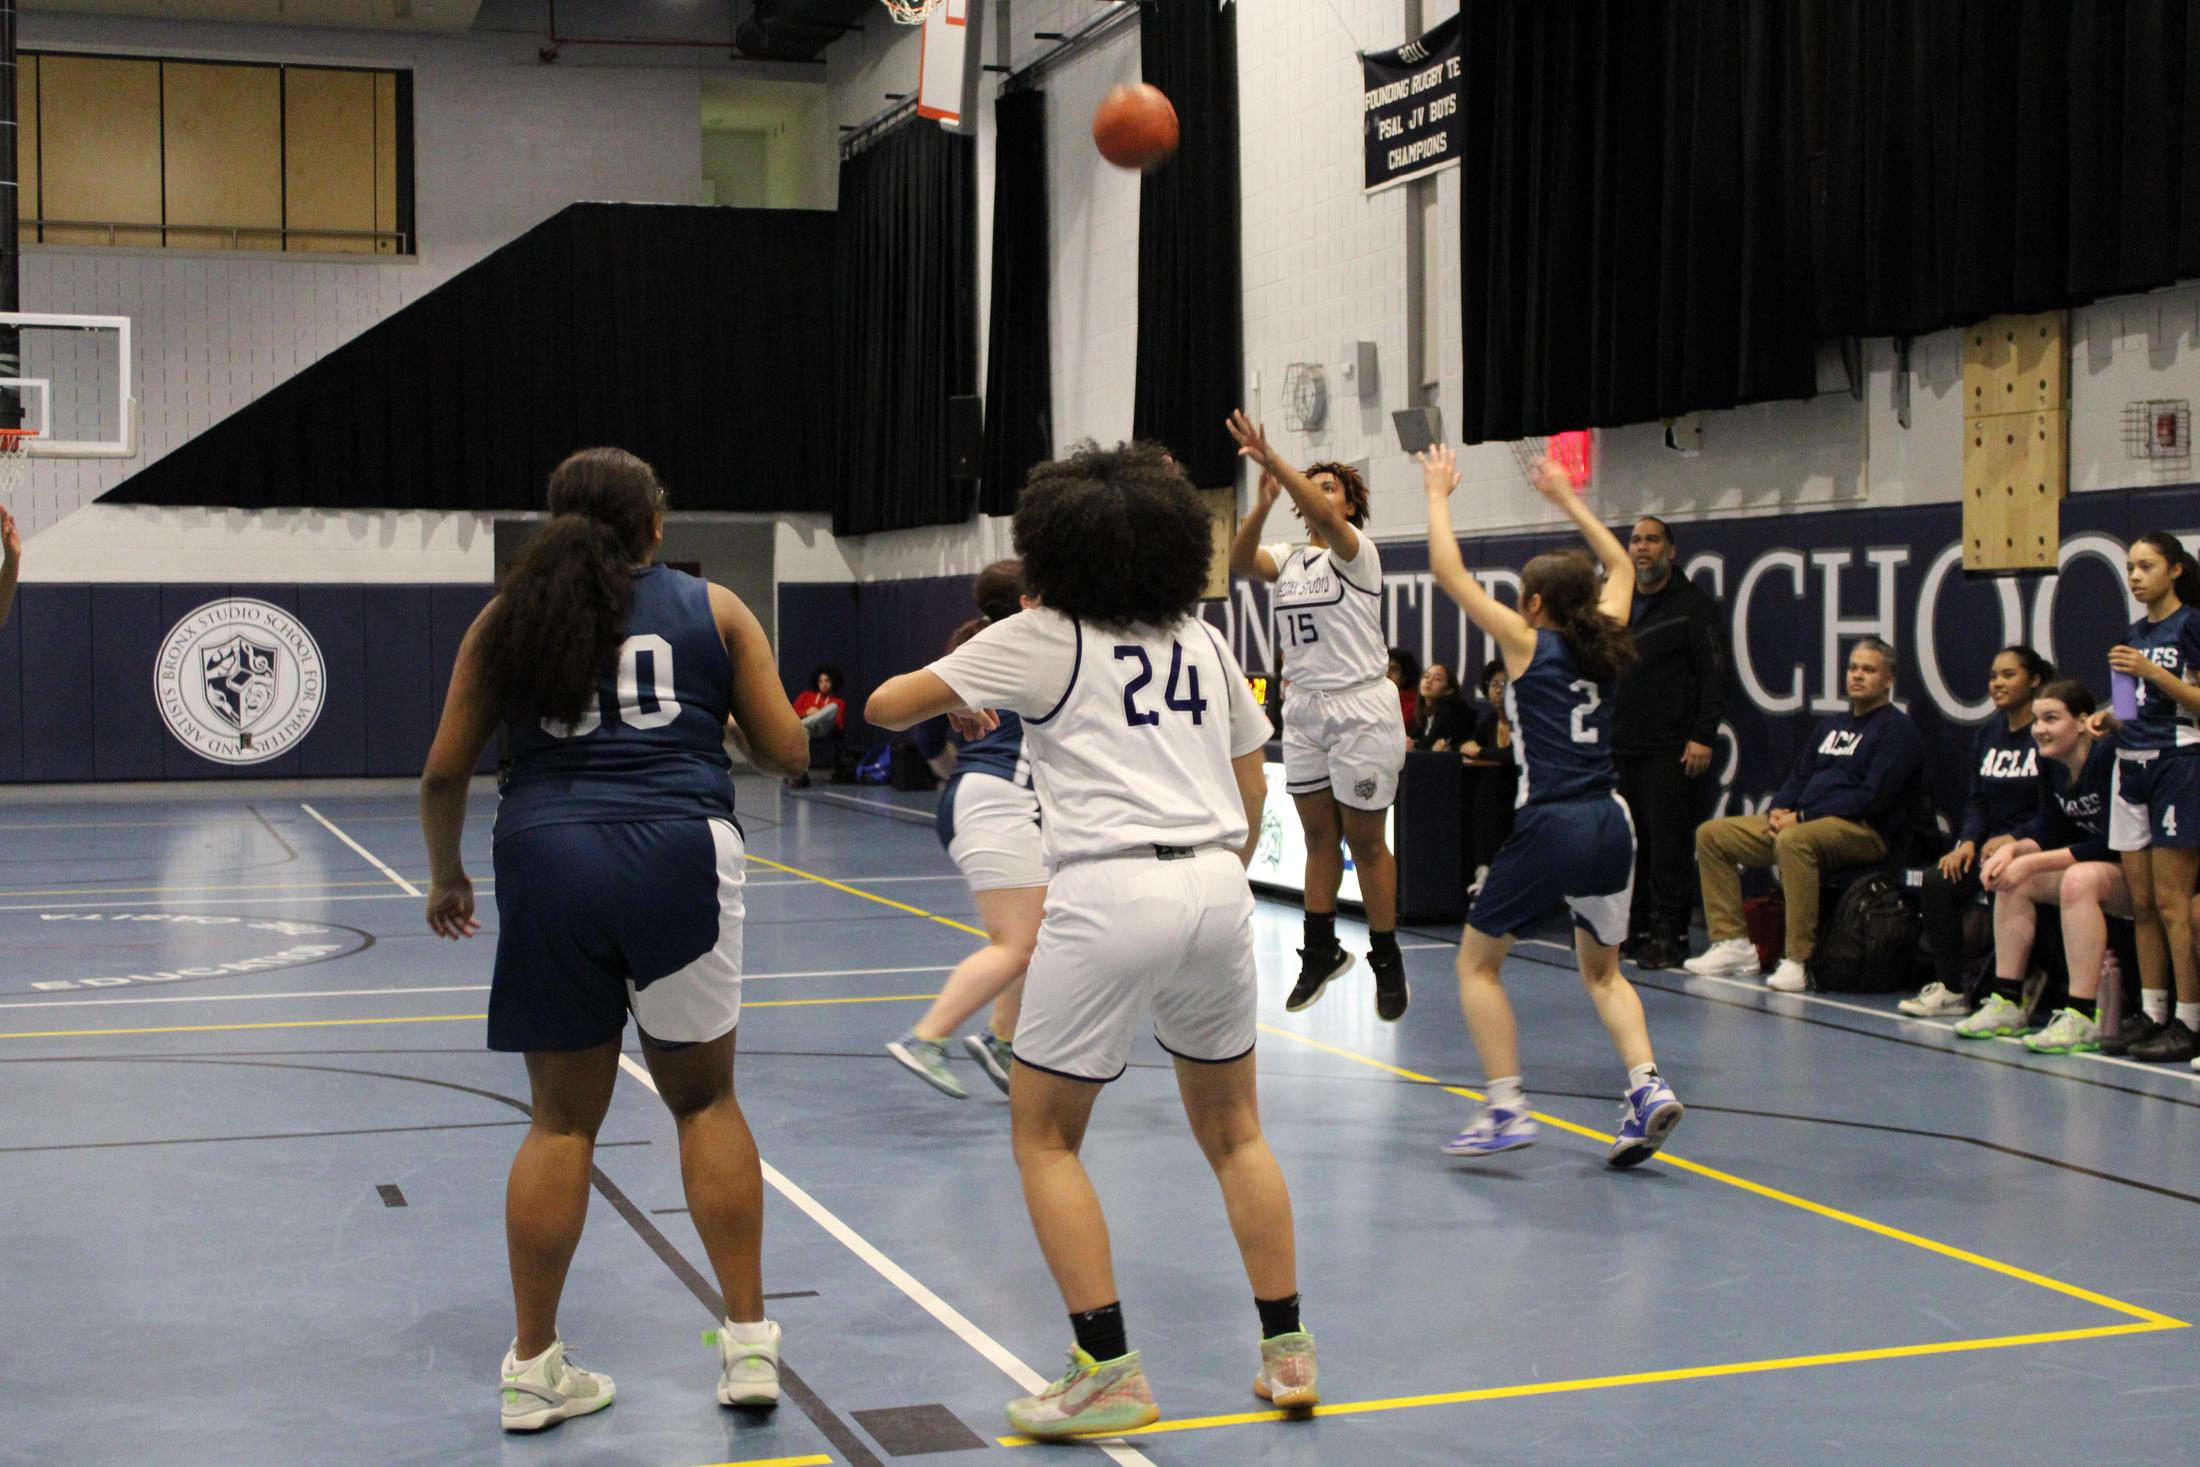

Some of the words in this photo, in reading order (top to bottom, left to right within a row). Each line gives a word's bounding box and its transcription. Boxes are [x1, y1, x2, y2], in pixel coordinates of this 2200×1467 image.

[1365, 78, 1410, 111] FOUNDING
[1411, 63, 1444, 95] RUGBY
[1378, 115, 1404, 141] PSAL
[1408, 106, 1425, 130] JV
[1430, 93, 1457, 123] BOYS
[1388, 131, 1448, 170] CHAMPIONS
[198, 607, 261, 628] STUDIO
[263, 613, 313, 666] SCHOOL
[1288, 613, 1319, 646] 15
[163, 625, 197, 680] BRONX
[304, 670, 318, 701] FOR
[541, 634, 682, 738] 0
[1113, 638, 1208, 727] 24
[163, 688, 204, 742] ARTISTS
[1568, 678, 1601, 744] 2
[1980, 747, 2039, 778] ACLA
[2161, 804, 2178, 837] 4
